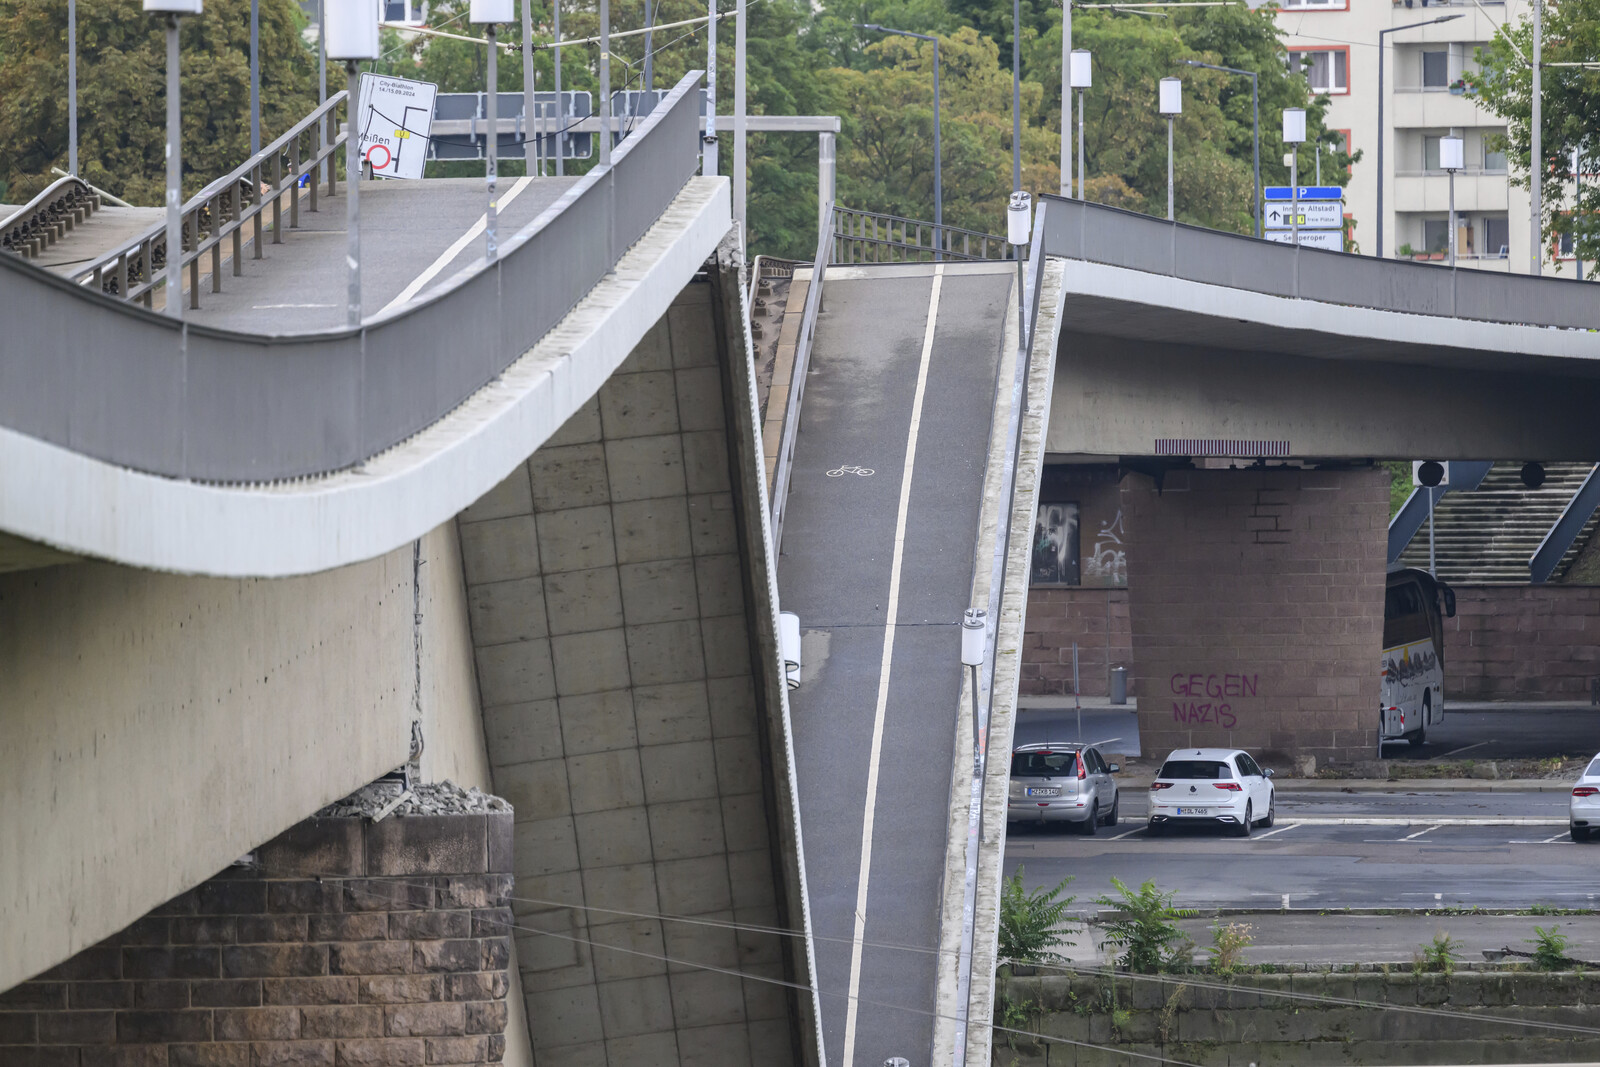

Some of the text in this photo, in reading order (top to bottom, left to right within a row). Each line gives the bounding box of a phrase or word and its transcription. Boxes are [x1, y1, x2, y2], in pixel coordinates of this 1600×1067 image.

[379, 80, 414, 91] City-Biathlon
[1300, 188, 1307, 199] P
[1283, 234, 1326, 242] Seperoper
[1170, 673, 1258, 700] GEGEN
[1172, 702, 1237, 728] NAZIS
